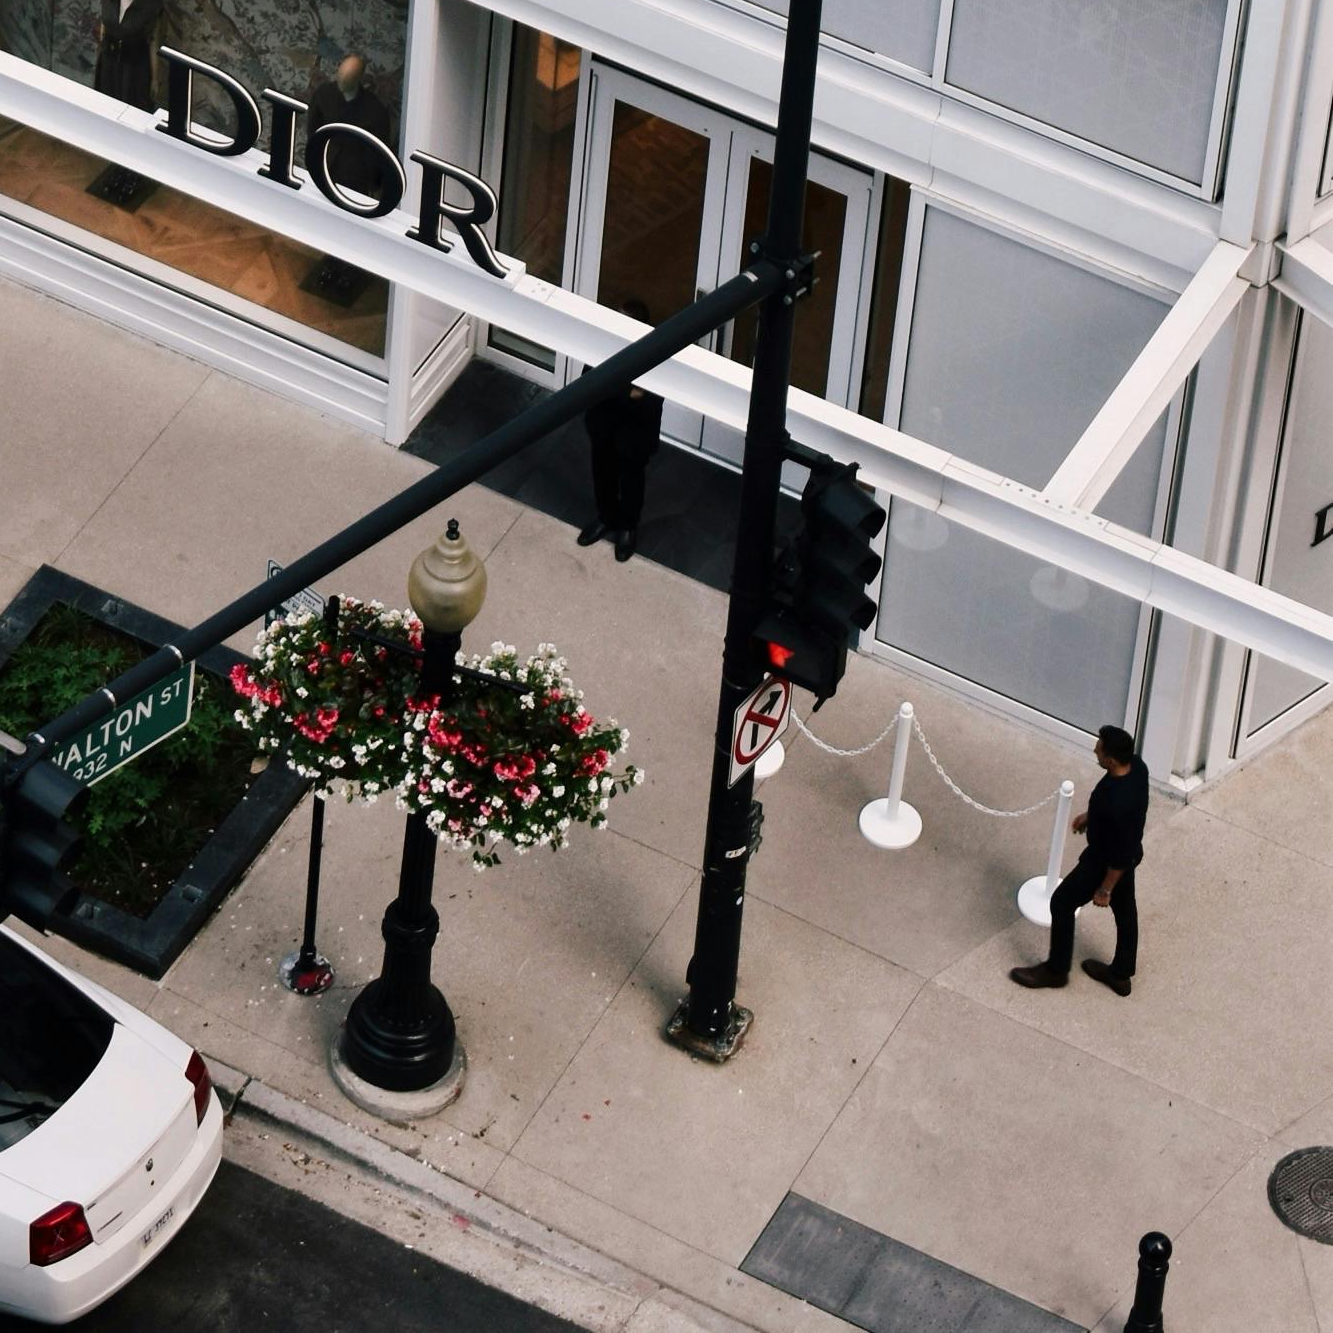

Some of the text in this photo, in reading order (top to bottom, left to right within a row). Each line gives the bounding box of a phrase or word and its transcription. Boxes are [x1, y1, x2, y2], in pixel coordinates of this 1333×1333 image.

[155, 45, 512, 279] DIOR
[159, 678, 184, 706] ST
[73, 735, 132, 781] 932 N
